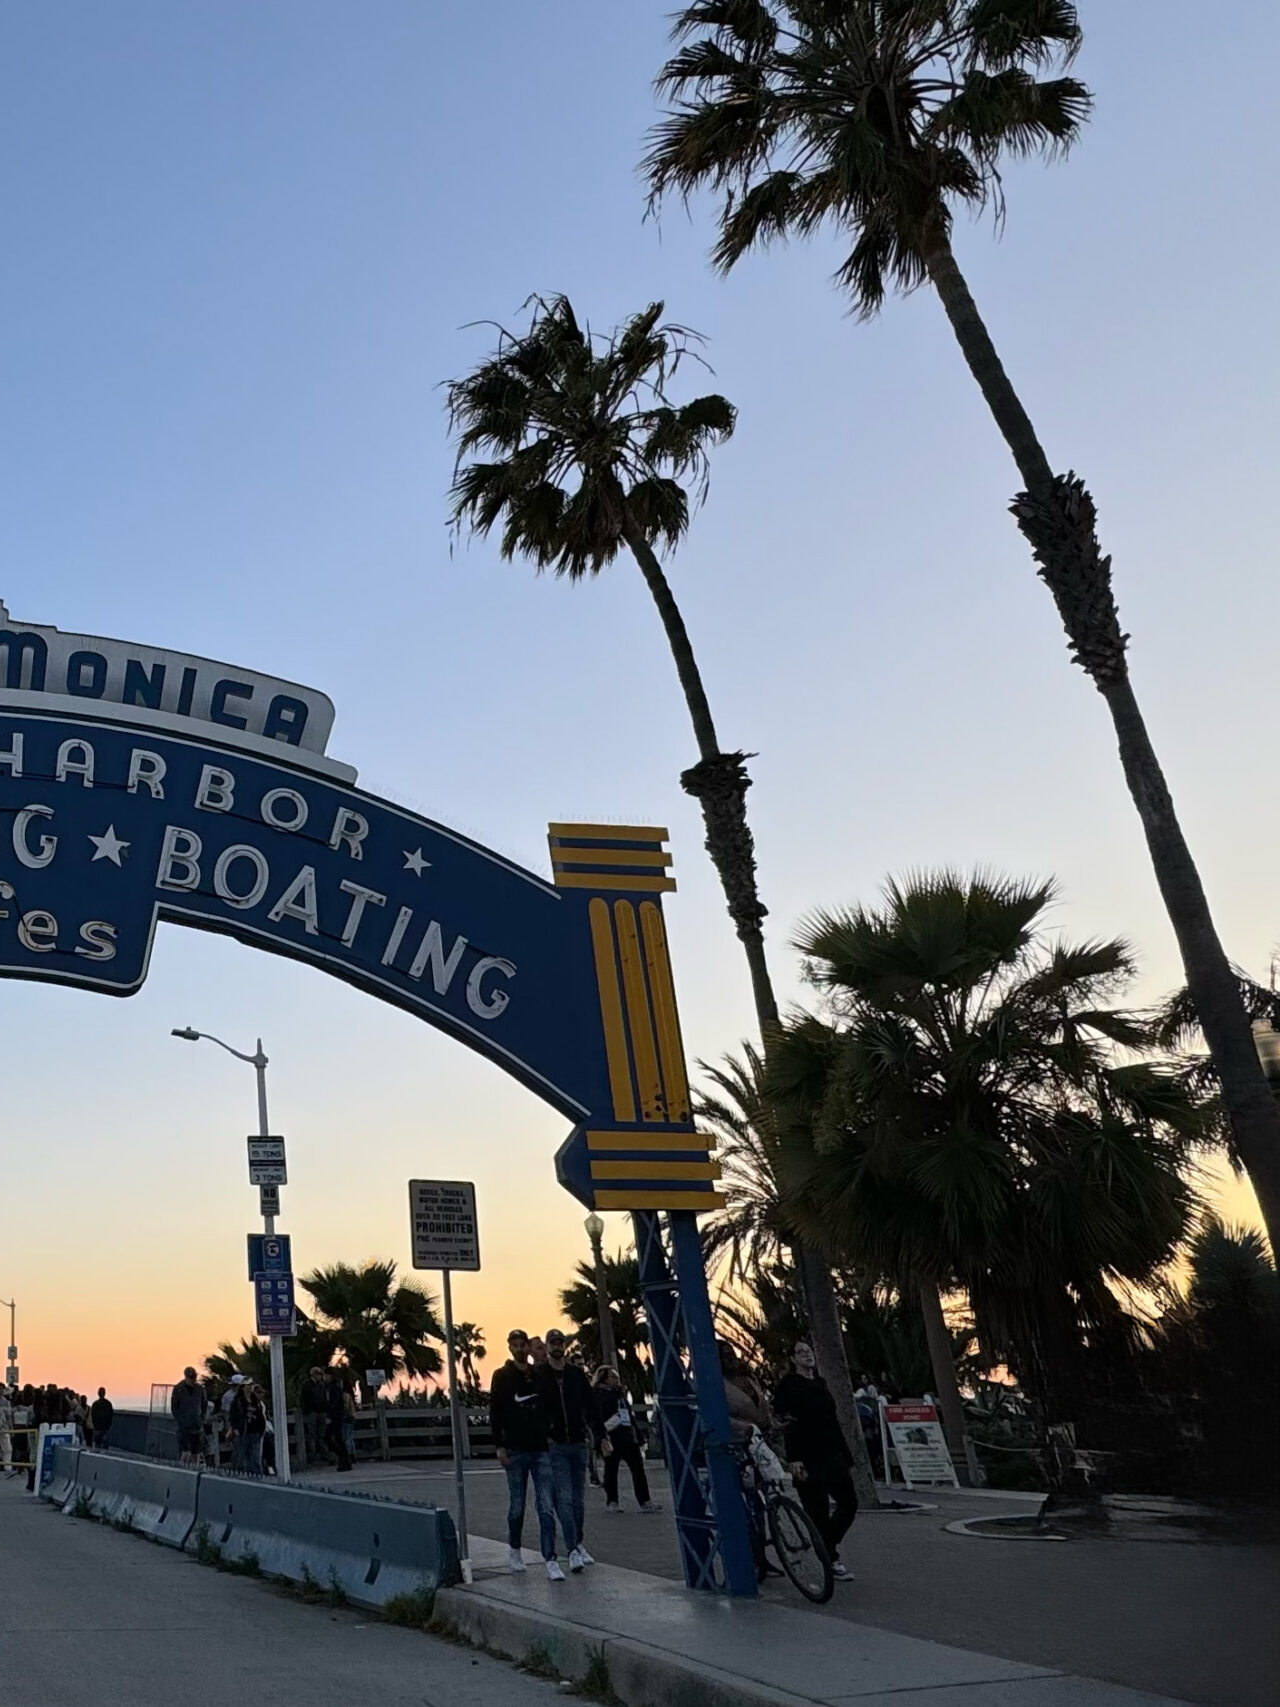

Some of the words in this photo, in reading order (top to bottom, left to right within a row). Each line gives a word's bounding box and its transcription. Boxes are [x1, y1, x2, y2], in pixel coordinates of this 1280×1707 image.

[156, 824, 518, 1020] BOATING
[262, 1150, 282, 1158] TONS
[263, 1188, 276, 1198] NO
[415, 1221, 473, 1234] PROHIBITED
